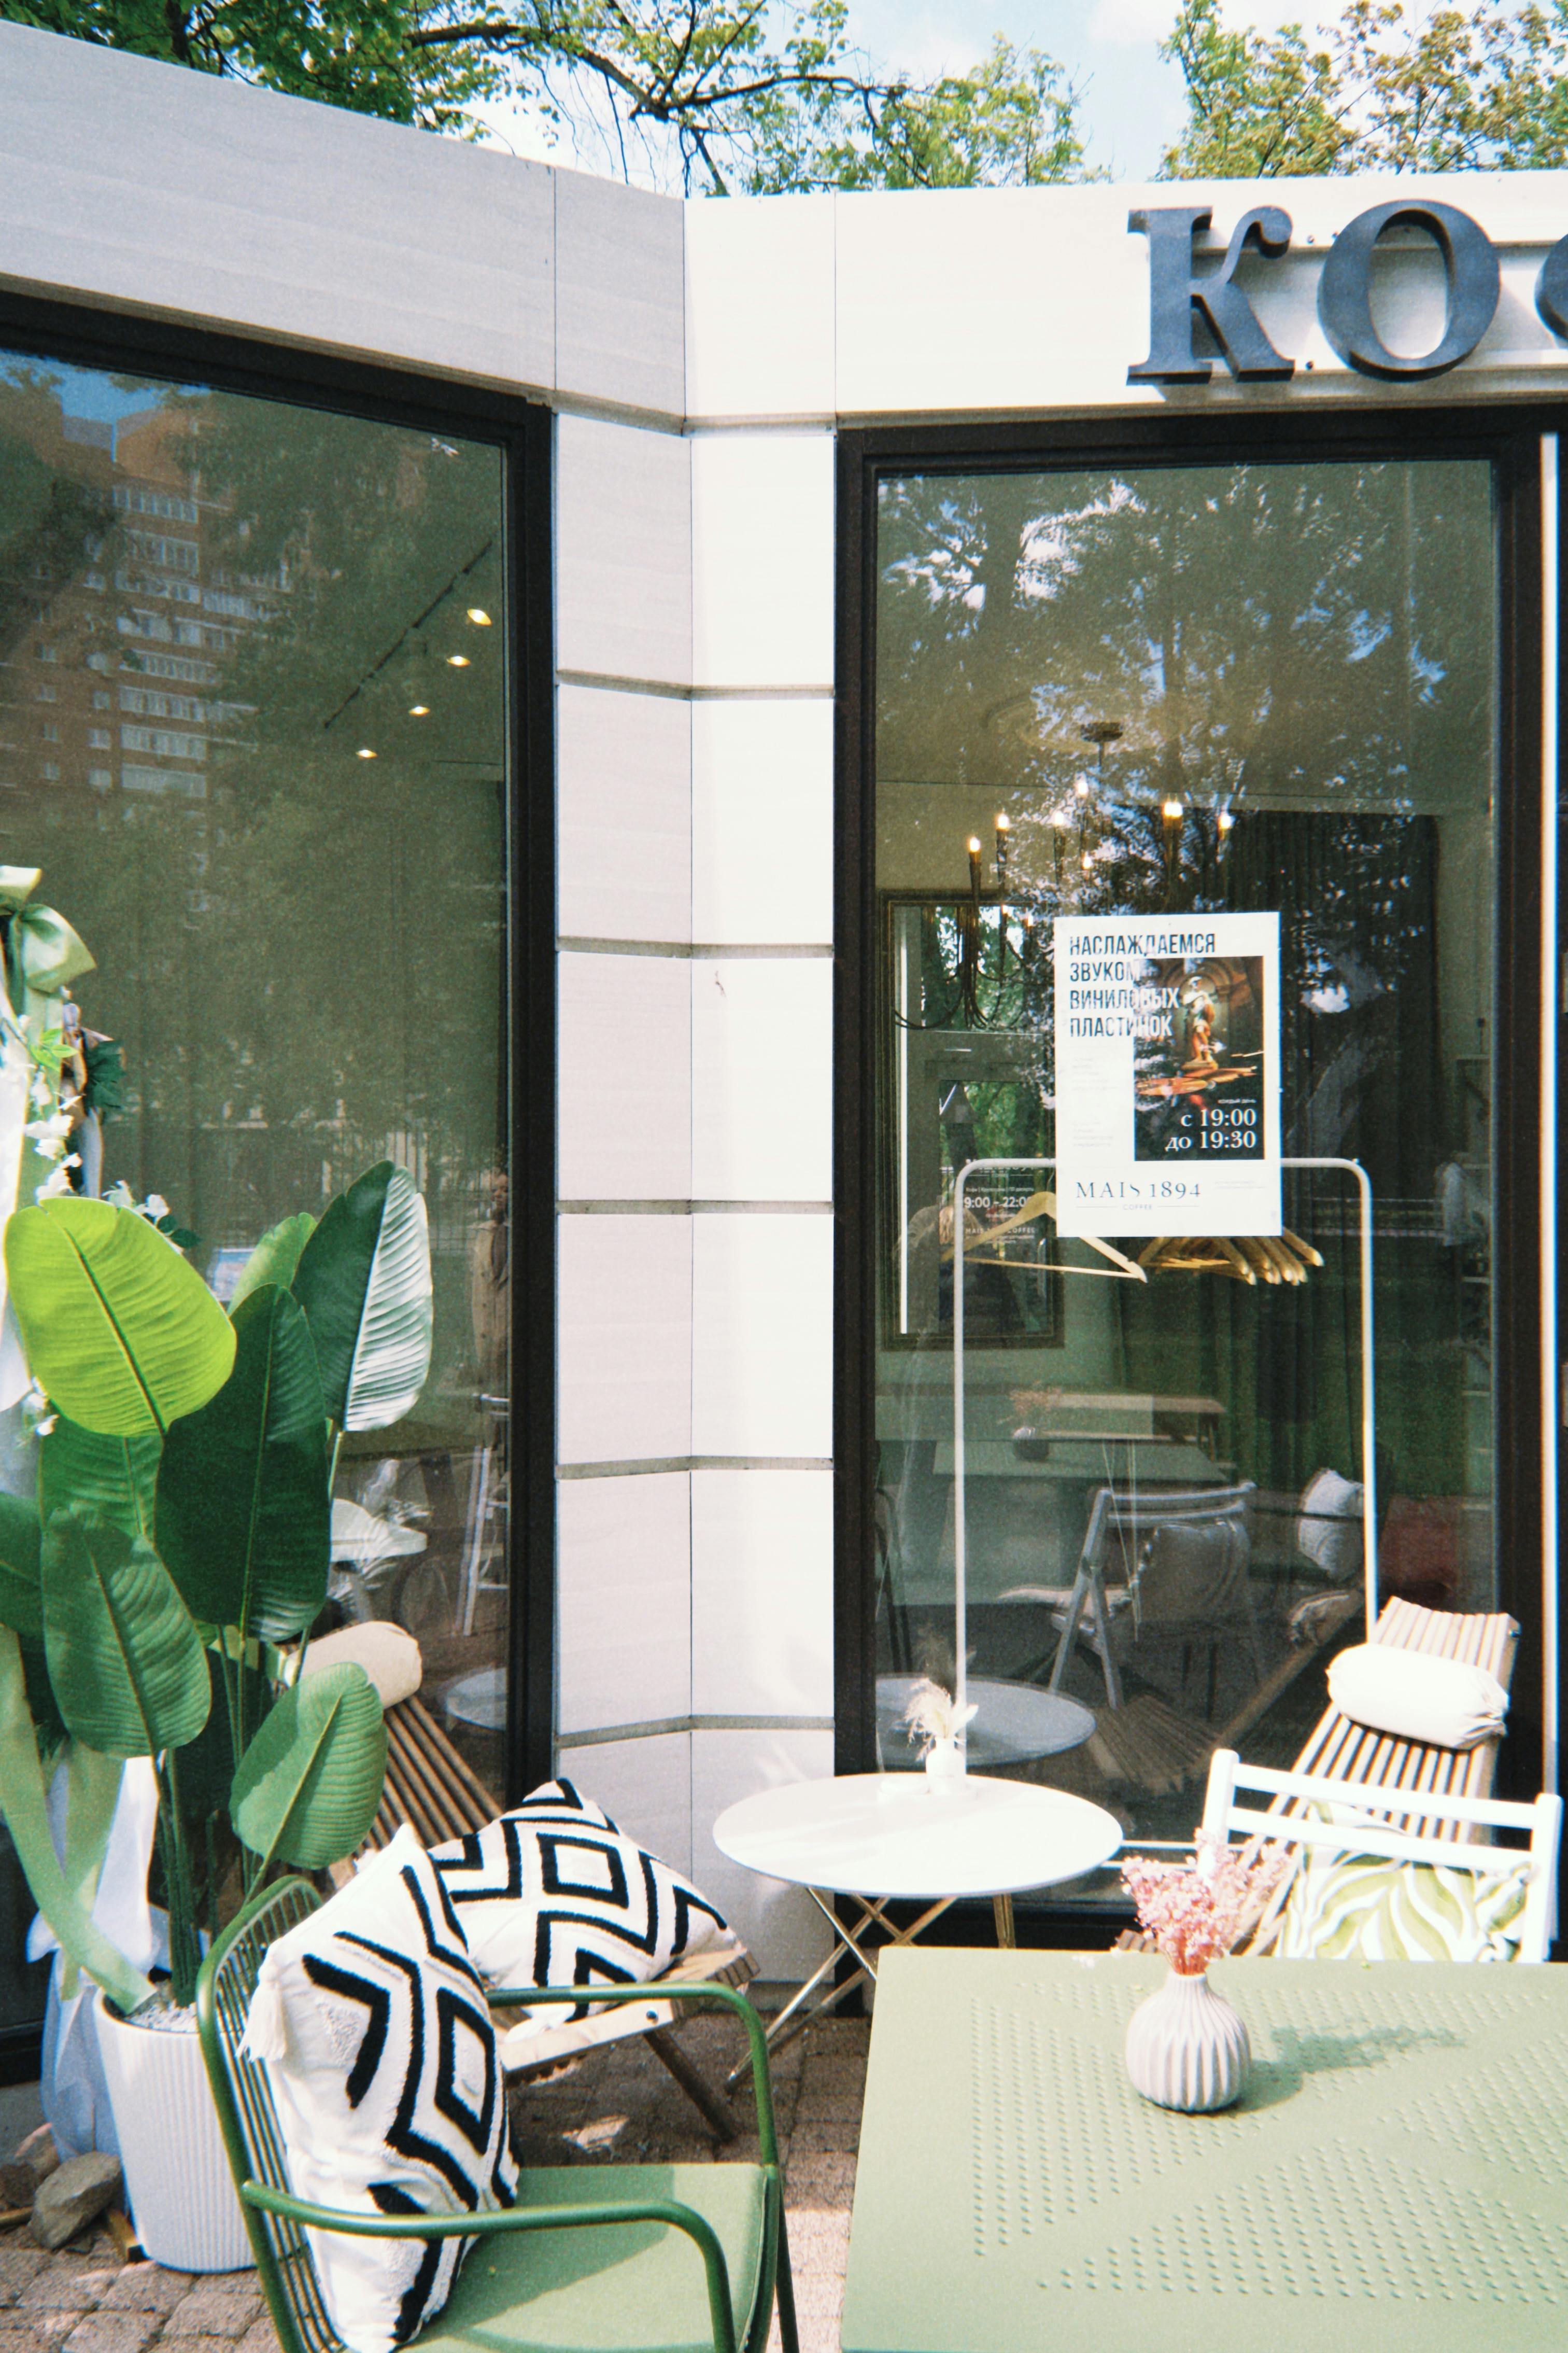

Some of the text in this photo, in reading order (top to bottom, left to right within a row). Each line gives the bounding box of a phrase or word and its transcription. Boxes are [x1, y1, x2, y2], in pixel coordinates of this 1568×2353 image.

[1126, 199, 1568, 385] КО
[1070, 933, 1215, 956] НАСЛАЖДАЕМСЯ
[1070, 987, 1180, 1009] ВИНИЛОВЫХ
[1070, 1015, 1174, 1037] ПЛАСТИНОК
[1180, 1108, 1257, 1127] с 19:00
[1165, 1130, 1257, 1152] до 19:30
[1149, 1181, 1201, 1199] 1894
[964, 1196, 991, 1208] 9:00
